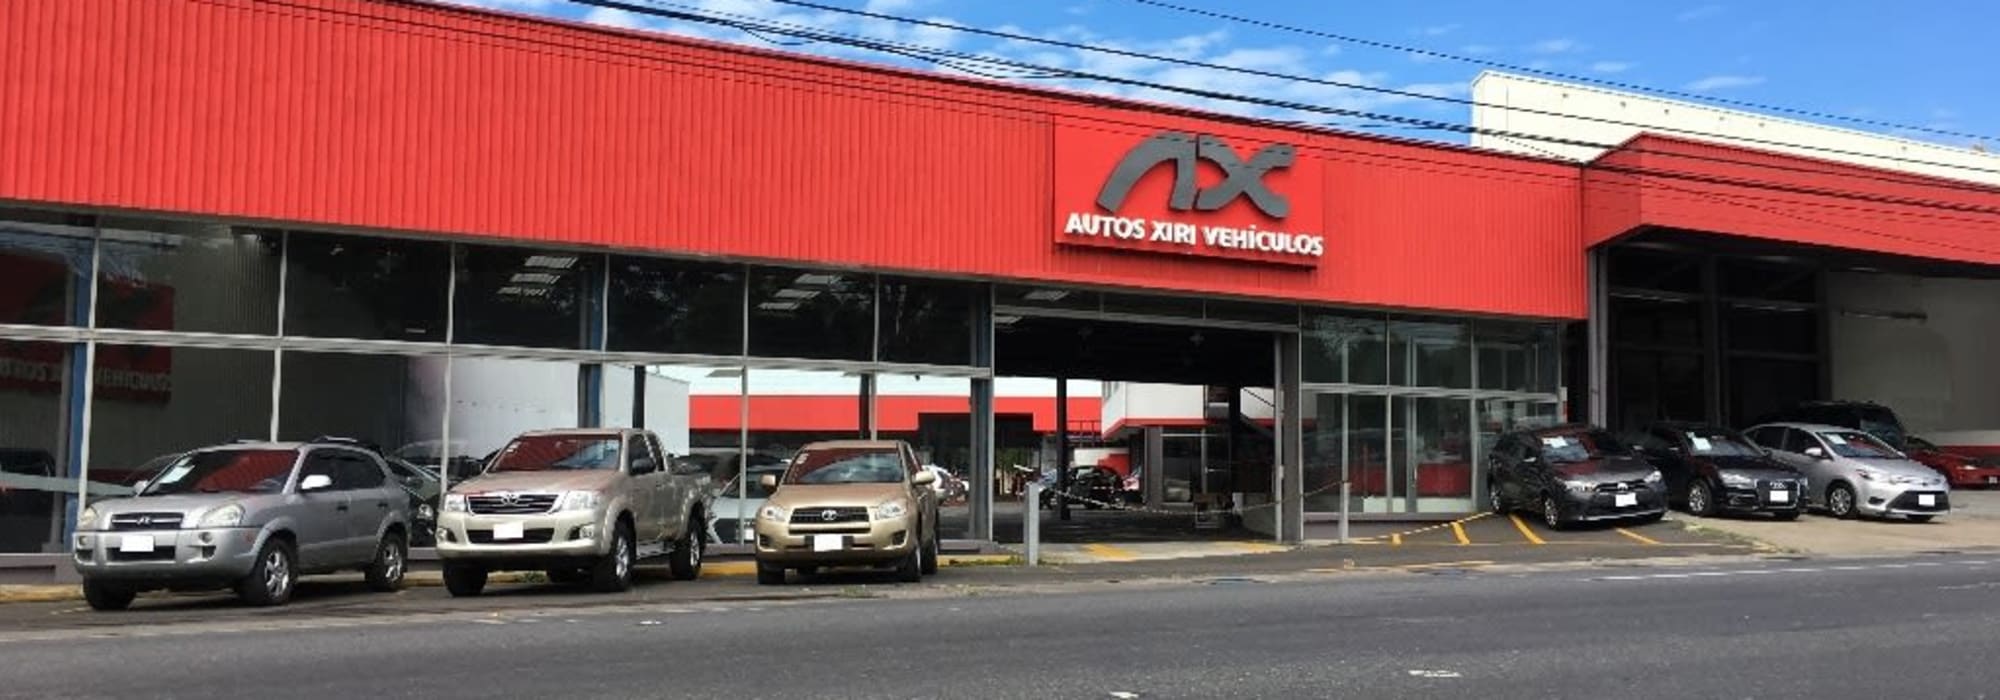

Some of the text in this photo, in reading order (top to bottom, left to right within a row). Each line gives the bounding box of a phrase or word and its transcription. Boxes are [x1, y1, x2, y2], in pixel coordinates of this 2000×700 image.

[1064, 212, 1324, 257] AUTOS XIRI VEHÍCULOS
